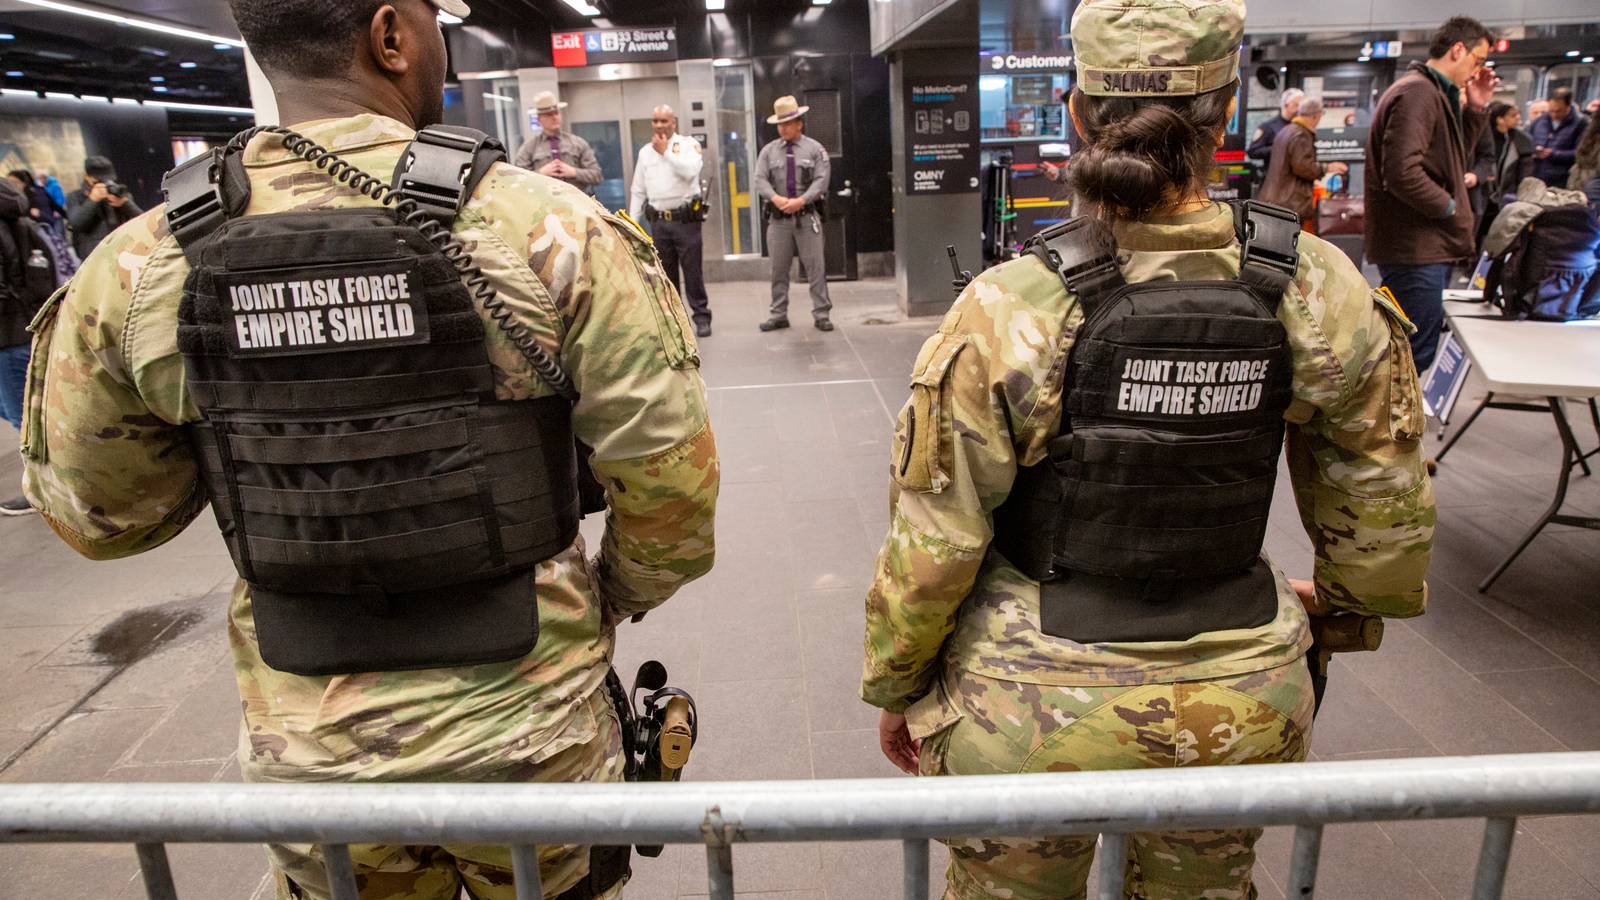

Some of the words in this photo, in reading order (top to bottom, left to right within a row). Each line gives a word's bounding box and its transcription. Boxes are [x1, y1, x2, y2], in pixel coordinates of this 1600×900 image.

[553, 33, 581, 49] Exit
[633, 30, 665, 41] Street
[666, 29, 676, 40] &
[619, 42, 626, 53] 7
[628, 41, 669, 52] Avenue
[1006, 55, 1072, 69] Customer
[1103, 73, 1168, 92] SALINAS
[914, 170, 945, 181] OMNY
[229, 282, 285, 312] JOINT
[288, 278, 343, 308] TASK
[344, 273, 411, 304] FORCE
[234, 309, 327, 349] EMPIRE
[328, 302, 416, 343] SHIELD
[1121, 358, 1174, 382] JOINT
[1175, 361, 1220, 383] TASK
[1219, 359, 1270, 383] FORCE
[1117, 381, 1197, 415] EMPIRE
[1198, 382, 1263, 415] SHIELD
